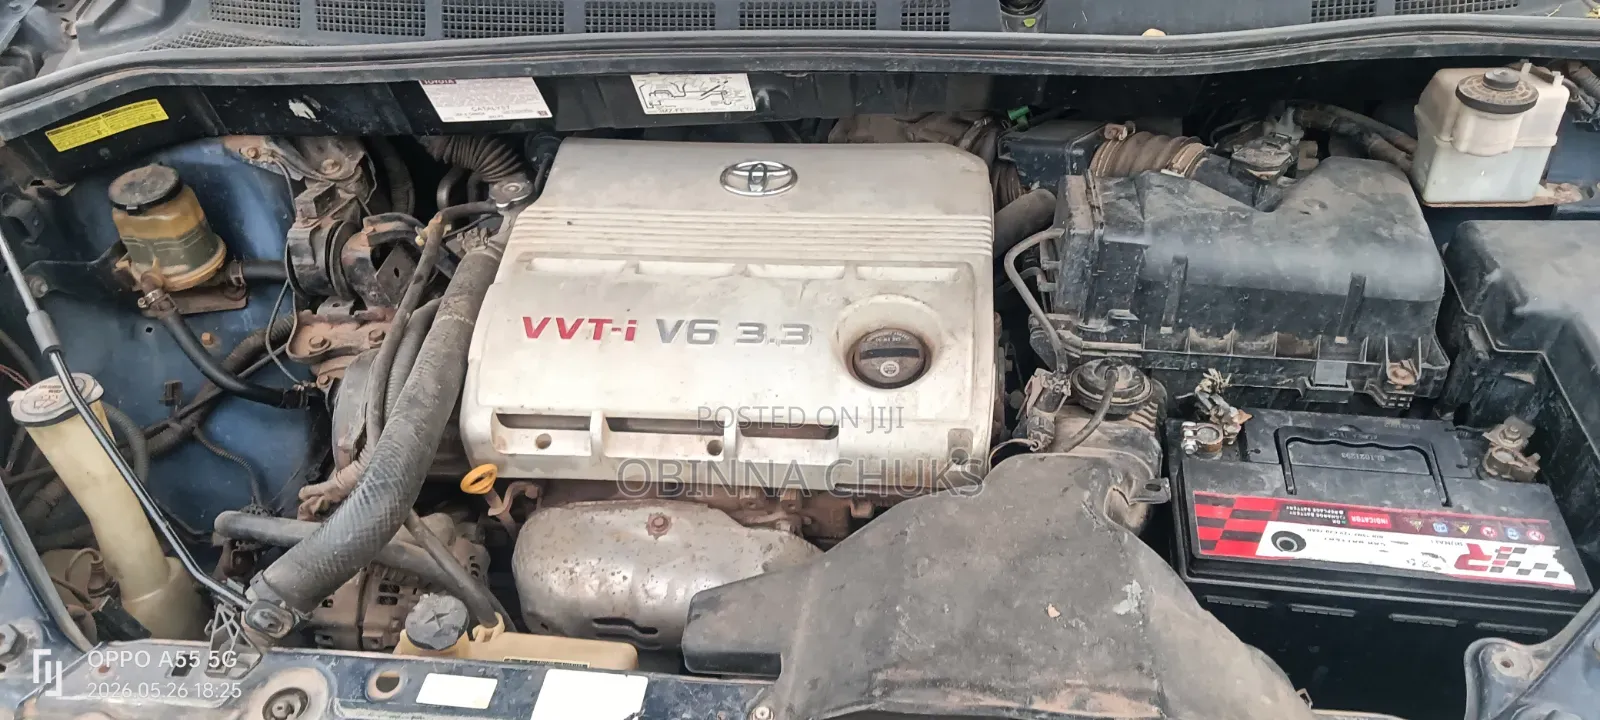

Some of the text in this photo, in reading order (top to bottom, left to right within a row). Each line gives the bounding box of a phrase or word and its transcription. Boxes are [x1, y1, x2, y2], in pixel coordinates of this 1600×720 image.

[522, 316, 811, 345] VVT-i V6 3.3
[1351, 515, 1389, 525] INDICATOR
